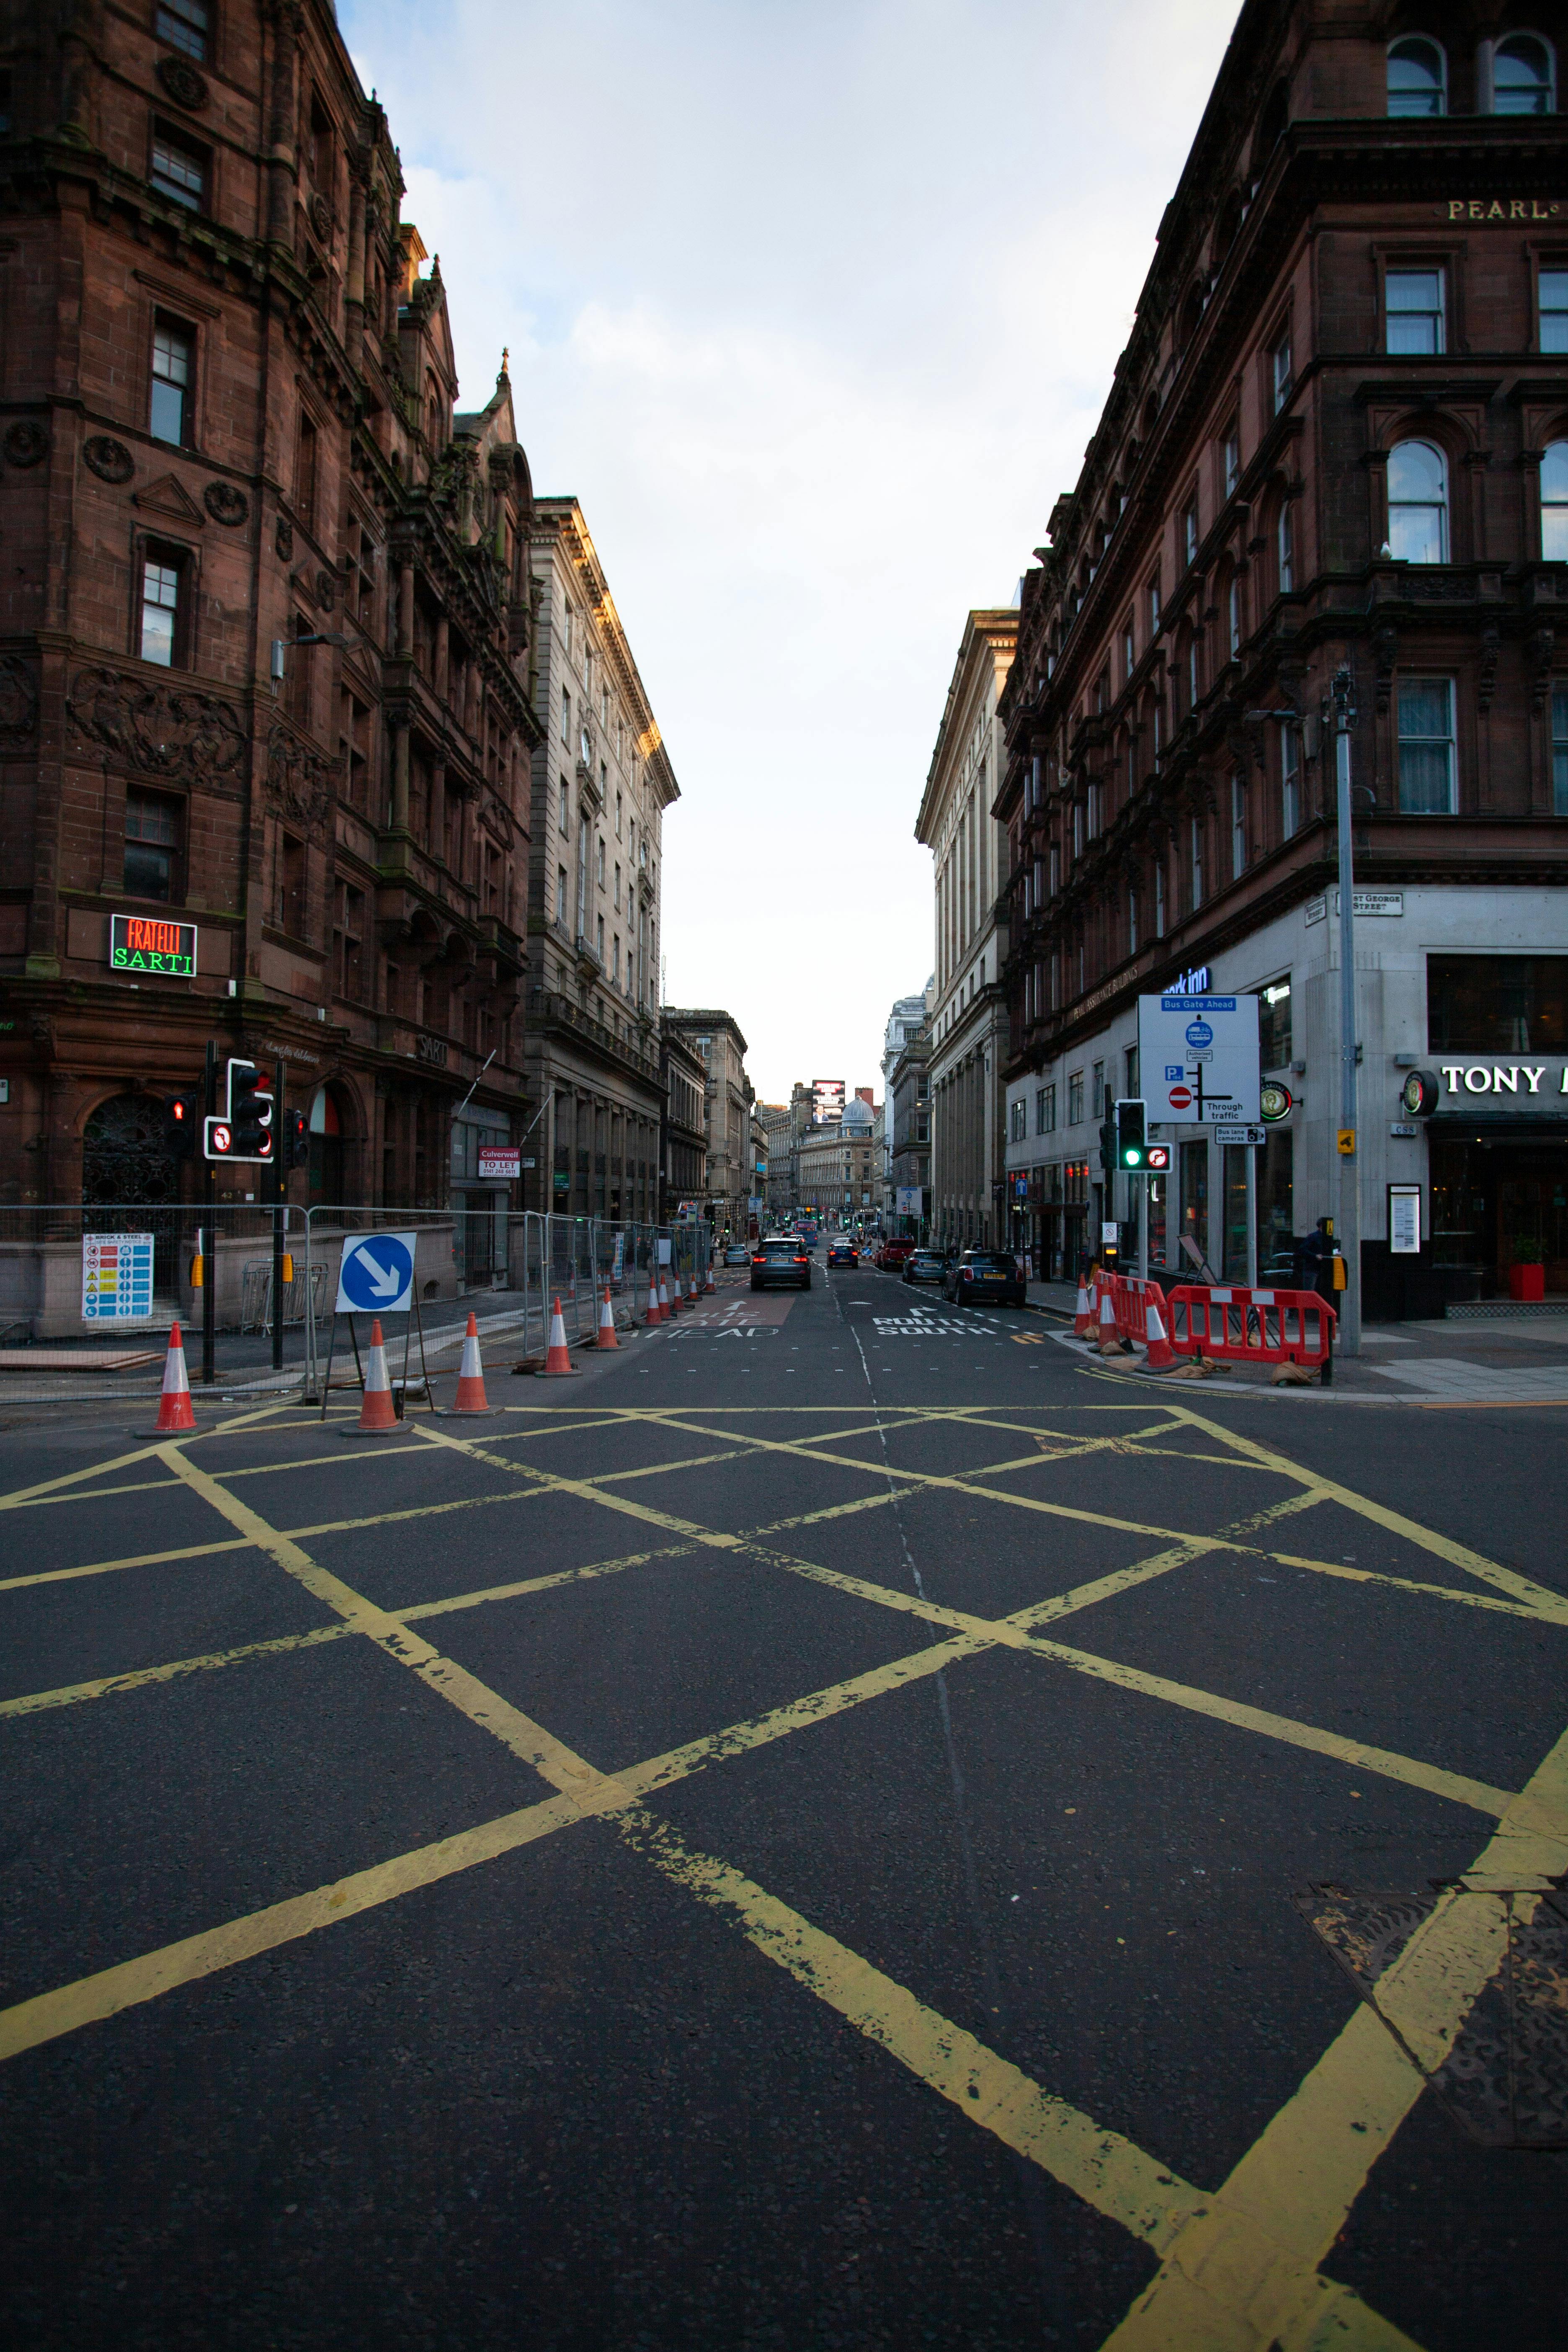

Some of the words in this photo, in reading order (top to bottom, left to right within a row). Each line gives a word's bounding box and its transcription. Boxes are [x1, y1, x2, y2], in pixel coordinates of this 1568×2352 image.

[1448, 200, 1548, 220] PEARL
[127, 918, 181, 954] FRATELLI
[114, 948, 192, 974] SARTI
[1188, 967, 1207, 994] inn
[1167, 1068, 1177, 1079] P
[1442, 1066, 1546, 1092] TONY
[1207, 1103, 1243, 1112] Through
